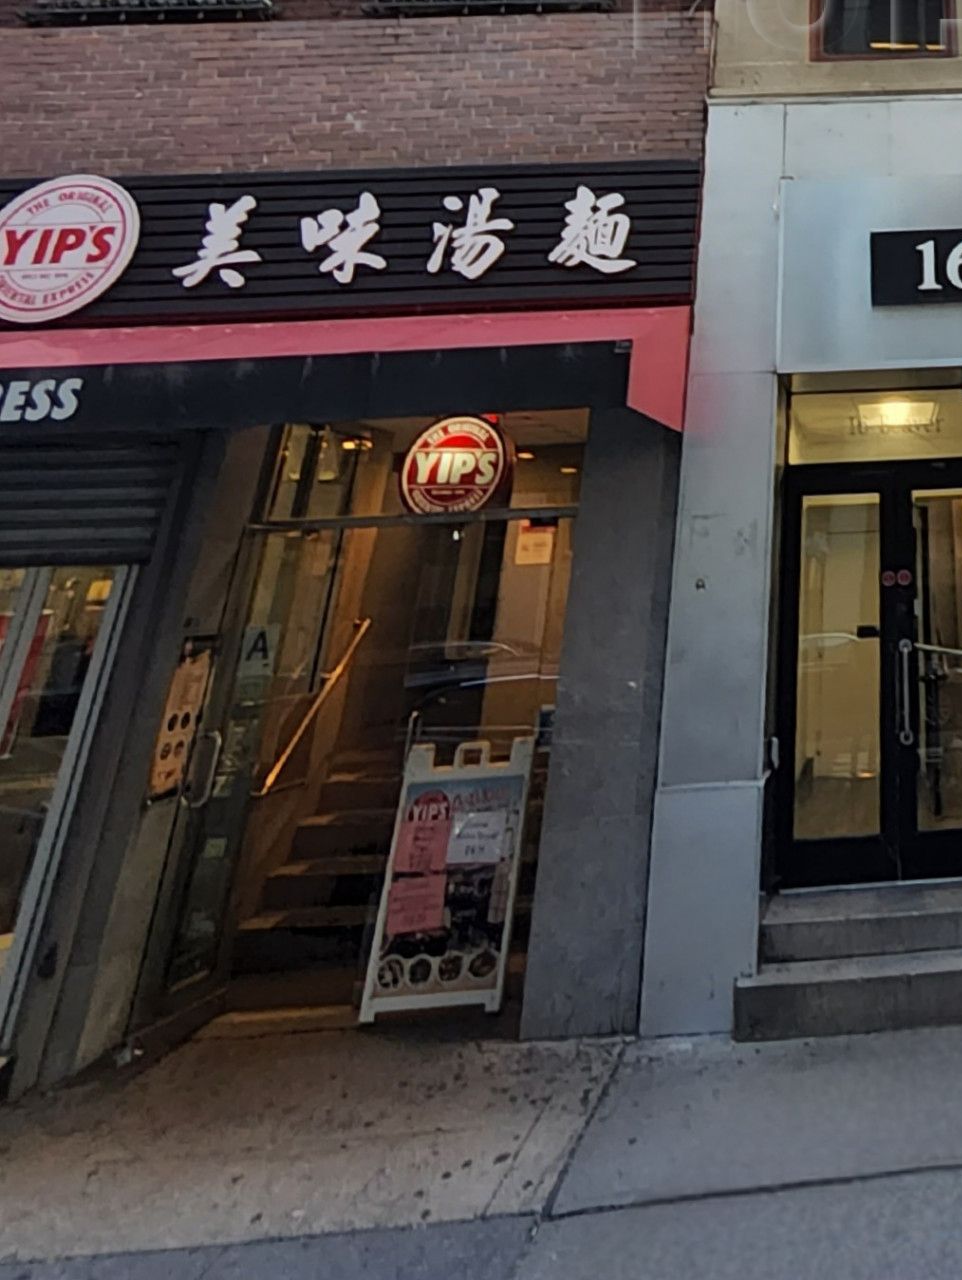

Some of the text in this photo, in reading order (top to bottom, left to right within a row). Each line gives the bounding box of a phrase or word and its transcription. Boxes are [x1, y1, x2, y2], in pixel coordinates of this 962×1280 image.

[3, 224, 117, 266] YIP'S
[0, 377, 84, 422] ESS
[415, 450, 498, 485] YIP'S
[245, 631, 269, 661] A
